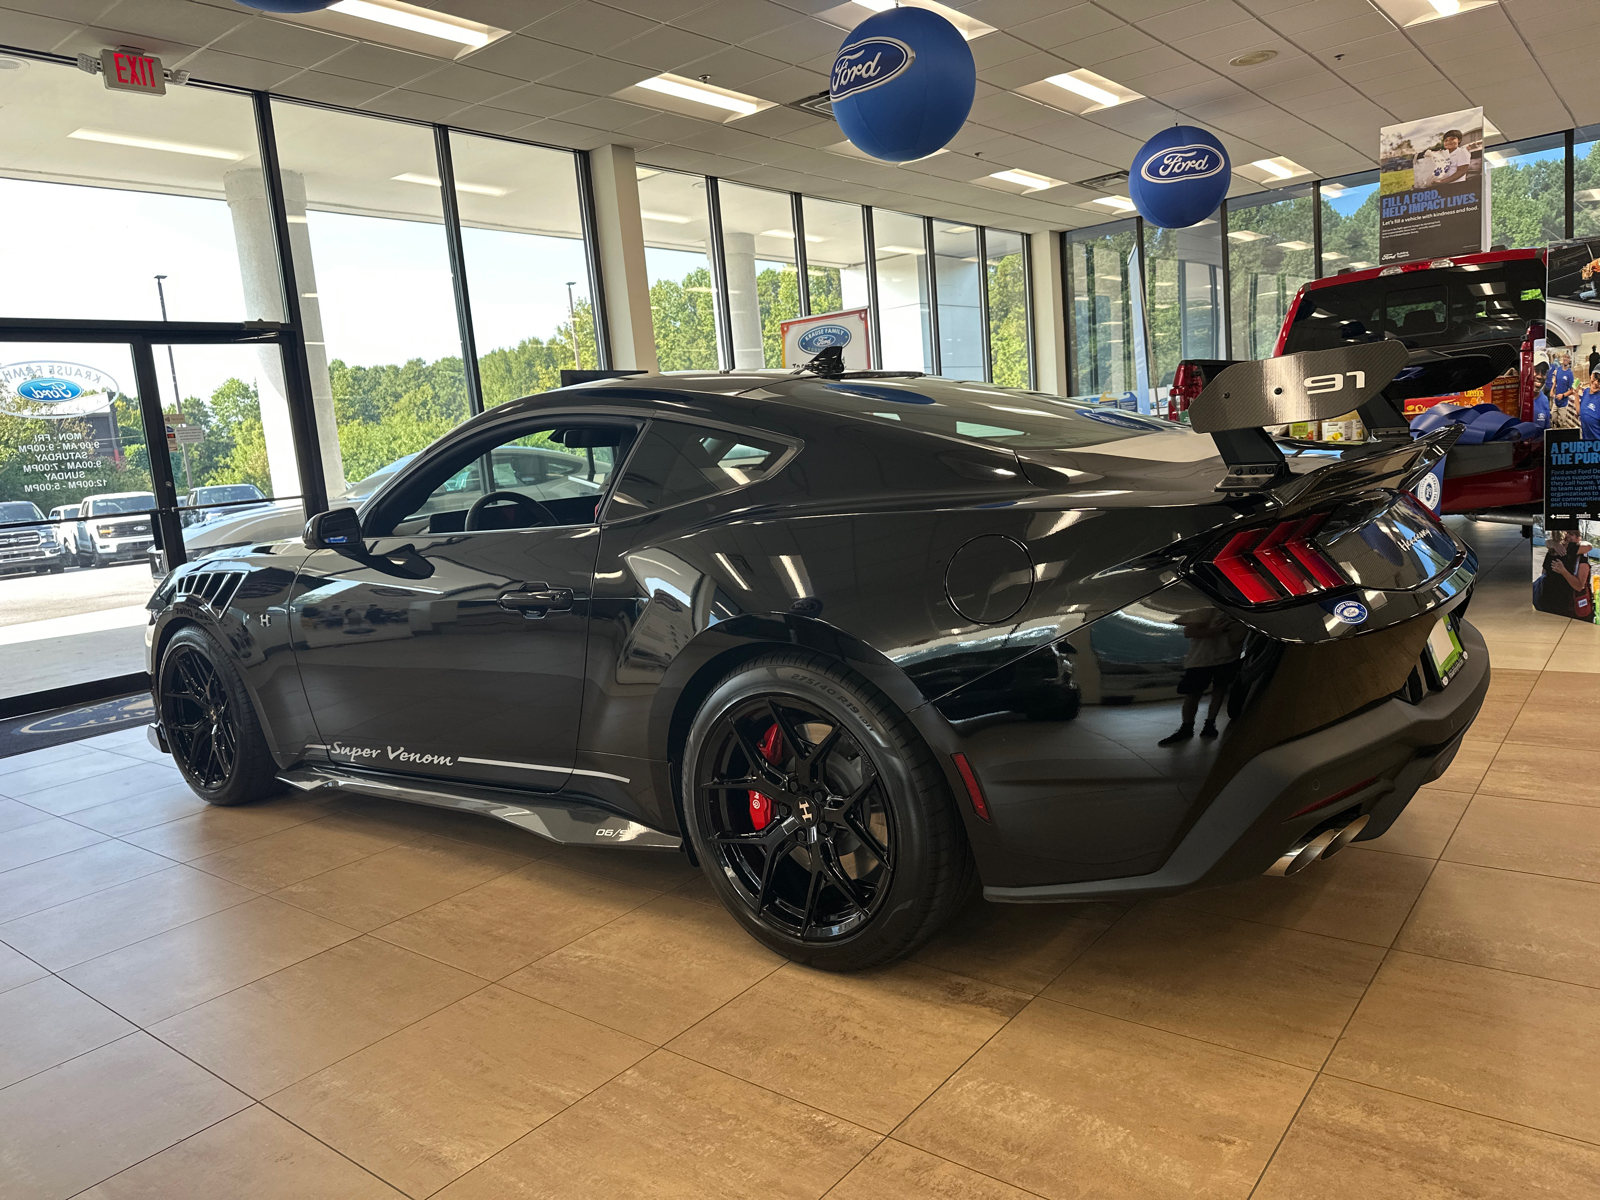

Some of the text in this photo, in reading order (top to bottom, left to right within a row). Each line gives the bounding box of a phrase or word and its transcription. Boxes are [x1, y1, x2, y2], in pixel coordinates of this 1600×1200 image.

[113, 52, 156, 88] EXIT
[832, 50, 881, 91] Ford
[1159, 151, 1209, 176] Ford
[1383, 190, 1441, 208] FILL A FORD.
[1383, 193, 1478, 218] HELP IMPACT LIVES.
[805, 329, 824, 341] KRAUSE
[816, 336, 832, 346] Ford
[1304, 370, 1366, 396] 91
[1551, 442, 1559, 454] A
[1551, 452, 1600, 465] THE PUR
[790, 673, 837, 695] 275/40
[837, 695, 860, 714] R19
[331, 741, 454, 766] Super Venom
[595, 828, 628, 838] 06/9
